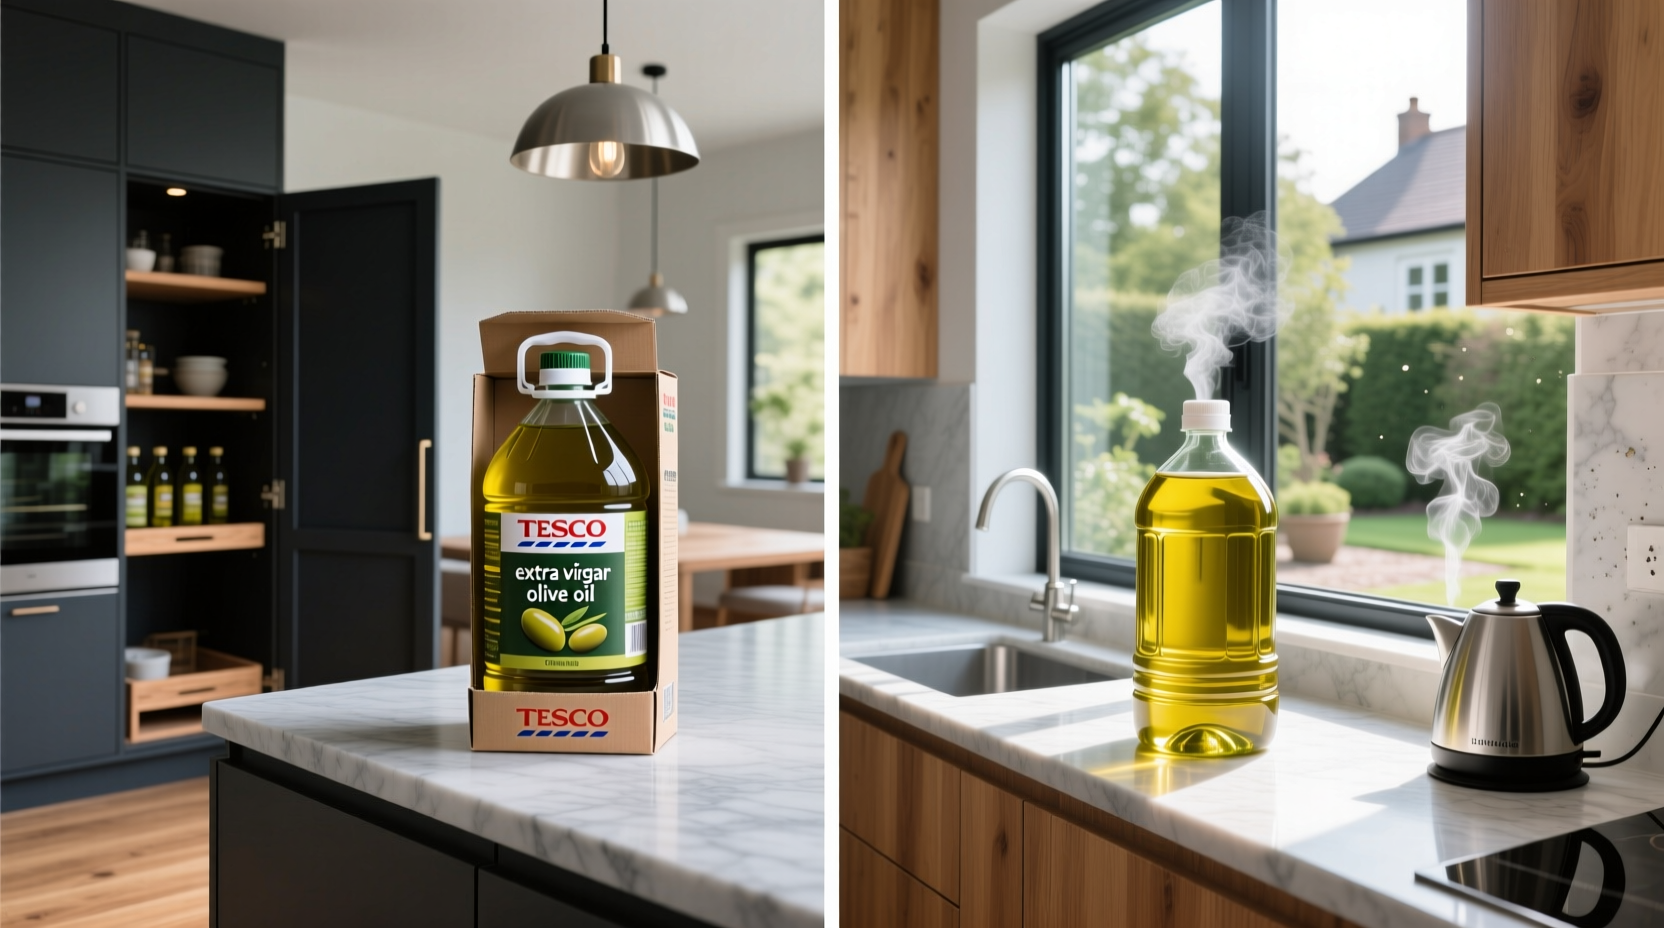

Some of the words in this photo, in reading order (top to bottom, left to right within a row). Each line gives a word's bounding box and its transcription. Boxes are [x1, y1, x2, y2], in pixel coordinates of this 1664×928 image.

[517, 519, 607, 538] TESCO
[515, 565, 559, 581] extra
[526, 583, 569, 602] olive
[573, 584, 595, 602] oil
[516, 708, 609, 727] TESCO
